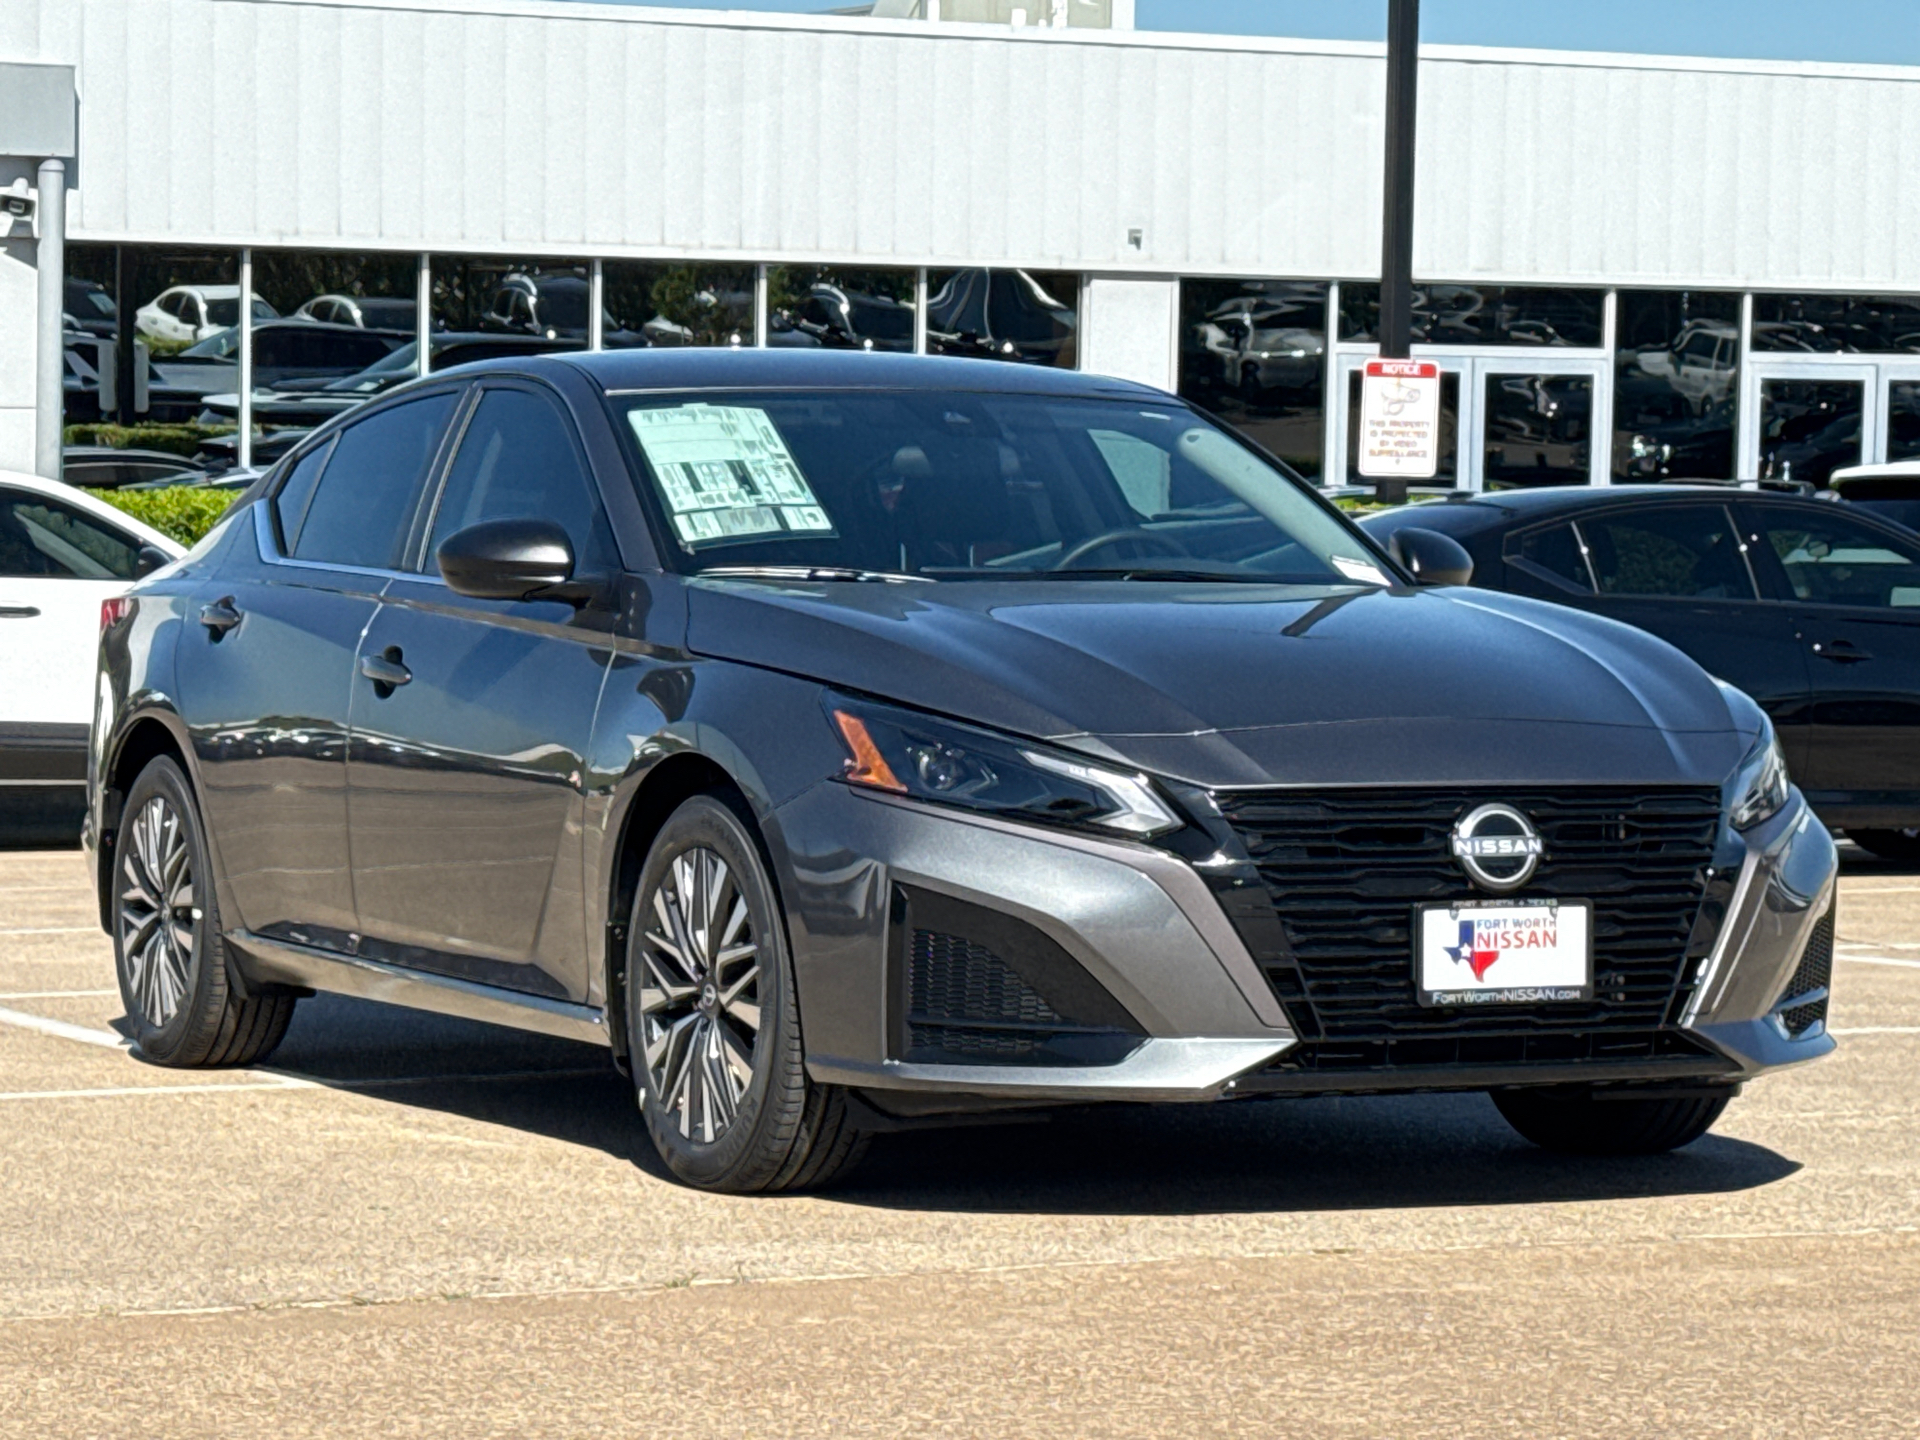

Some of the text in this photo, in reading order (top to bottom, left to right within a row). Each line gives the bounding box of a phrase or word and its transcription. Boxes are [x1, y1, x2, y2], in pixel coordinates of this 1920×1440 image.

[1381, 363, 1421, 376] NOTICE
[1389, 420, 1430, 429] PROPERTY
[1381, 430, 1428, 439] PROTECTED
[1455, 838, 1543, 855] NISSAN
[1476, 917, 1557, 930] FORT WORTH
[1476, 930, 1557, 949] NISSAN
